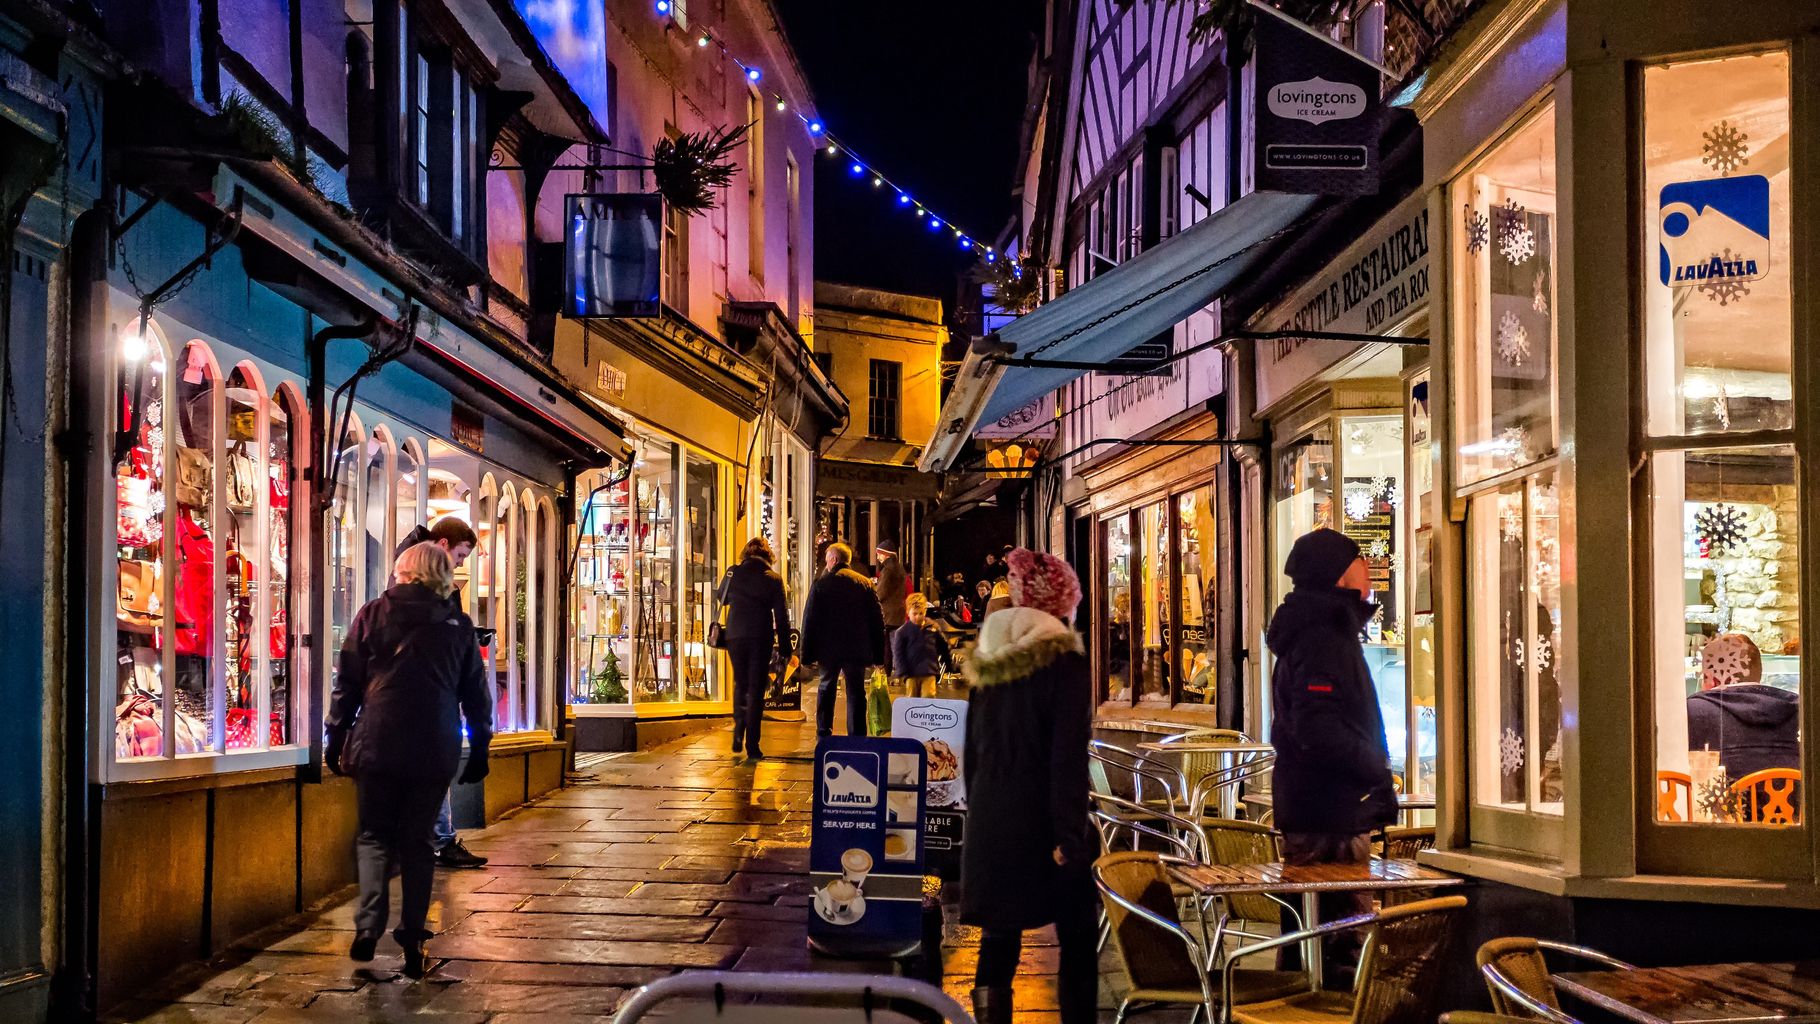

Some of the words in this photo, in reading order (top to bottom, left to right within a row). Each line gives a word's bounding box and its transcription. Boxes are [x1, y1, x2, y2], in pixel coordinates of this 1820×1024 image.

[1277, 89, 1357, 108] lovingtons
[1675, 257, 1758, 281] LAVAZZA
[1294, 282, 1340, 348] SETTLE
[1342, 208, 1429, 313] RESTAURA
[1365, 298, 1385, 333] AND
[1387, 282, 1409, 317] TEA
[911, 710, 952, 721] lovingtons
[831, 792, 871, 803] LAVAZZA
[823, 821, 854, 829] SERVED
[856, 822, 877, 830] HERE
[925, 817, 951, 826] LABLE
